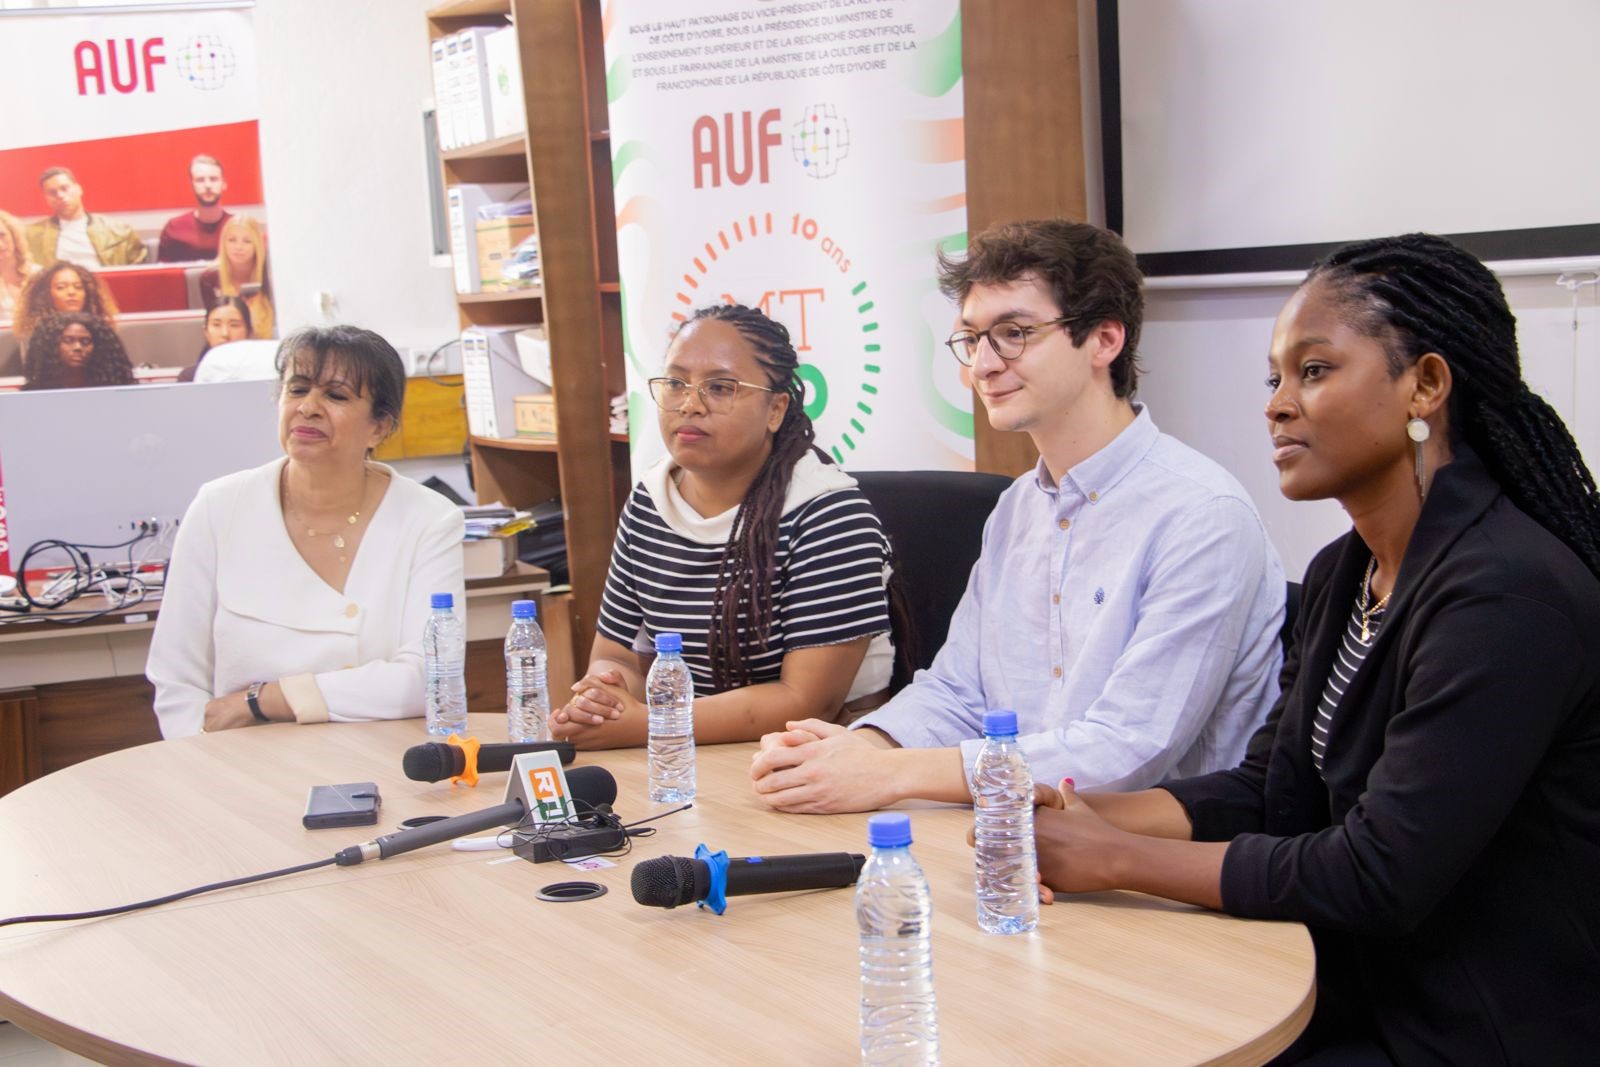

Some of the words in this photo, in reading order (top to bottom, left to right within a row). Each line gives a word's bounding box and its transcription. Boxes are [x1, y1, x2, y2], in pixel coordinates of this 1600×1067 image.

[629, 23, 650, 34] SOUS
[652, 22, 662, 32] LE
[664, 18, 686, 29] HAUT
[689, 11, 739, 25] PATRONAGE
[741, 11, 754, 20] DU
[756, 0, 827, 17] VICE-PRÉSIDENT
[649, 35, 660, 45] DE
[662, 31, 685, 43] CÔTE
[726, 25, 750, 36] SOUS
[752, 23, 763, 33] LA
[764, 16, 820, 31] PRÉSIDENCE
[821, 16, 834, 26] DU
[835, 10, 878, 23] MINISTRE
[880, 8, 894, 19] DE
[632, 46, 702, 62] L'ENSEIGNEMENT
[704, 41, 751, 55] SUPÉRIEUR
[753, 40, 764, 50] ET
[766, 38, 778, 49] DE
[780, 38, 792, 48] LA
[793, 31, 846, 46] RECHERCHE
[632, 68, 642, 78] ET
[644, 66, 666, 77] SOUS
[667, 65, 679, 74] LE
[680, 59, 733, 73] PARRAINAGE
[734, 58, 746, 68] DE
[748, 57, 760, 67] LA
[761, 52, 803, 65] MINISTRE
[804, 51, 817, 61] DE
[818, 49, 829, 59] LA
[830, 45, 871, 58] CULTURE
[873, 43, 885, 53] ET
[887, 41, 901, 52] DE
[903, 40, 917, 50] LA
[74, 37, 166, 95] AUF
[656, 77, 723, 91] FRANCOPHONIE
[725, 75, 737, 86] DE
[739, 74, 750, 84] LA
[752, 67, 807, 82] RÉPUBLIQUE
[808, 66, 820, 77] DE
[822, 63, 846, 76] CÔTE
[847, 59, 887, 73] D'IVOIRE
[693, 108, 782, 189] AUF
[792, 213, 818, 241] 10
[821, 237, 851, 273] ans
[721, 288, 824, 351] T
